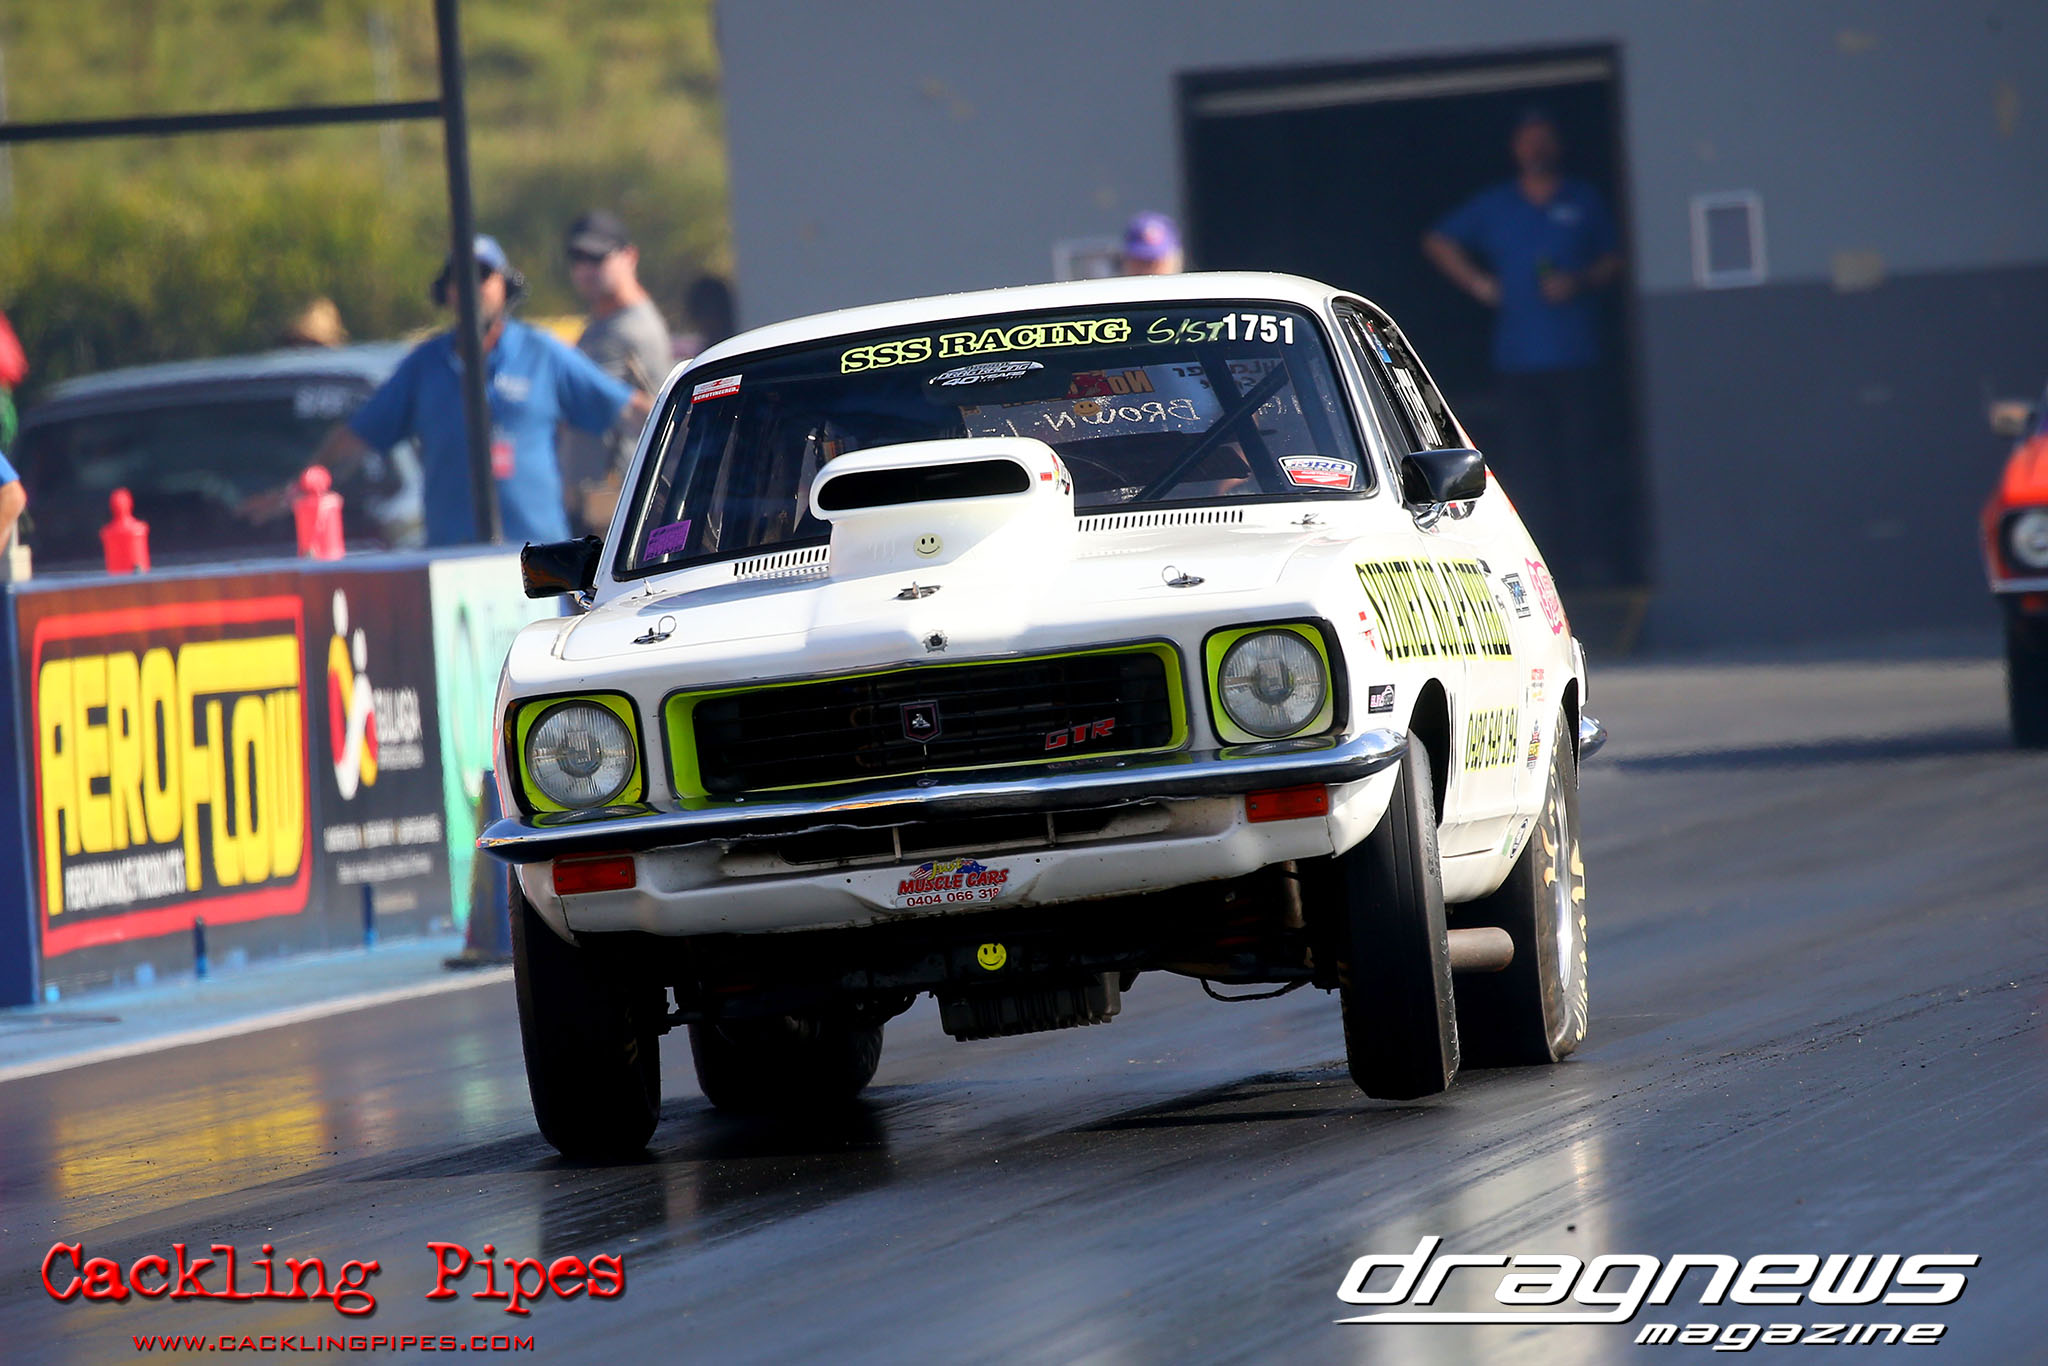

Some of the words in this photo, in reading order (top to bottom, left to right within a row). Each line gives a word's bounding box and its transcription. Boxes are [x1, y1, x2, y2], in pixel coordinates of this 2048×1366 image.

[1223, 313, 1294, 345] 1751
[841, 336, 931, 374] SSS
[938, 320, 1132, 358] RACING
[941, 375, 981, 386] 40
[1354, 561, 1437, 662] SYDNEY
[1045, 717, 1115, 750] GTR
[898, 873, 964, 895] MUSCLE
[965, 868, 1010, 888] CARS
[928, 858, 963, 881] Just
[906, 894, 942, 908] 0404
[946, 890, 974, 903] 066
